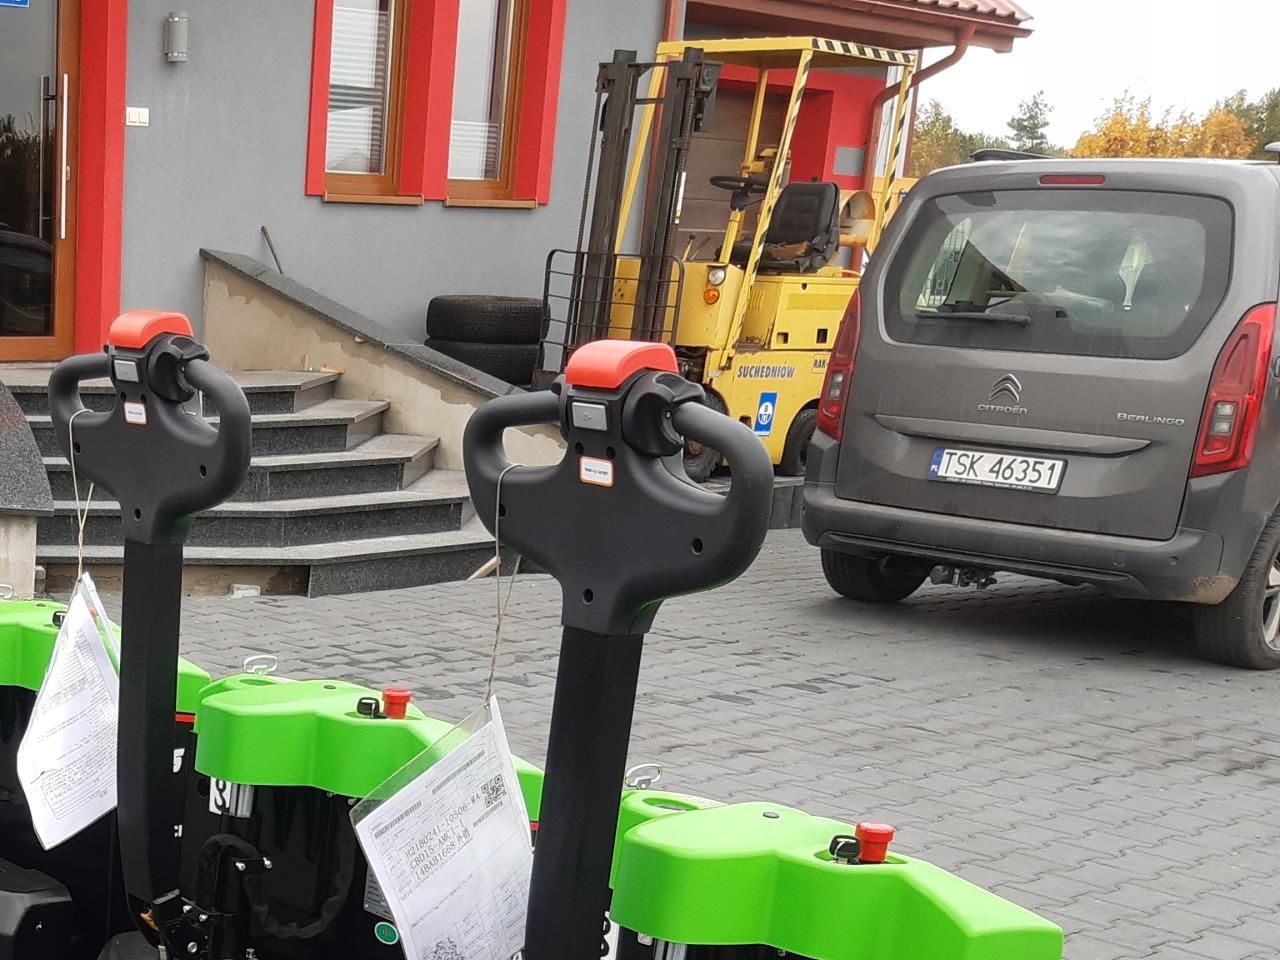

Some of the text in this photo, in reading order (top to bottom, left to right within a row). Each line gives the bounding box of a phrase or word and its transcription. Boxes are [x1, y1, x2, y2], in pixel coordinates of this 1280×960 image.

[1116, 412, 1185, 426] BERLINGO
[944, 452, 984, 477] TSK
[989, 456, 1056, 485] 46351
